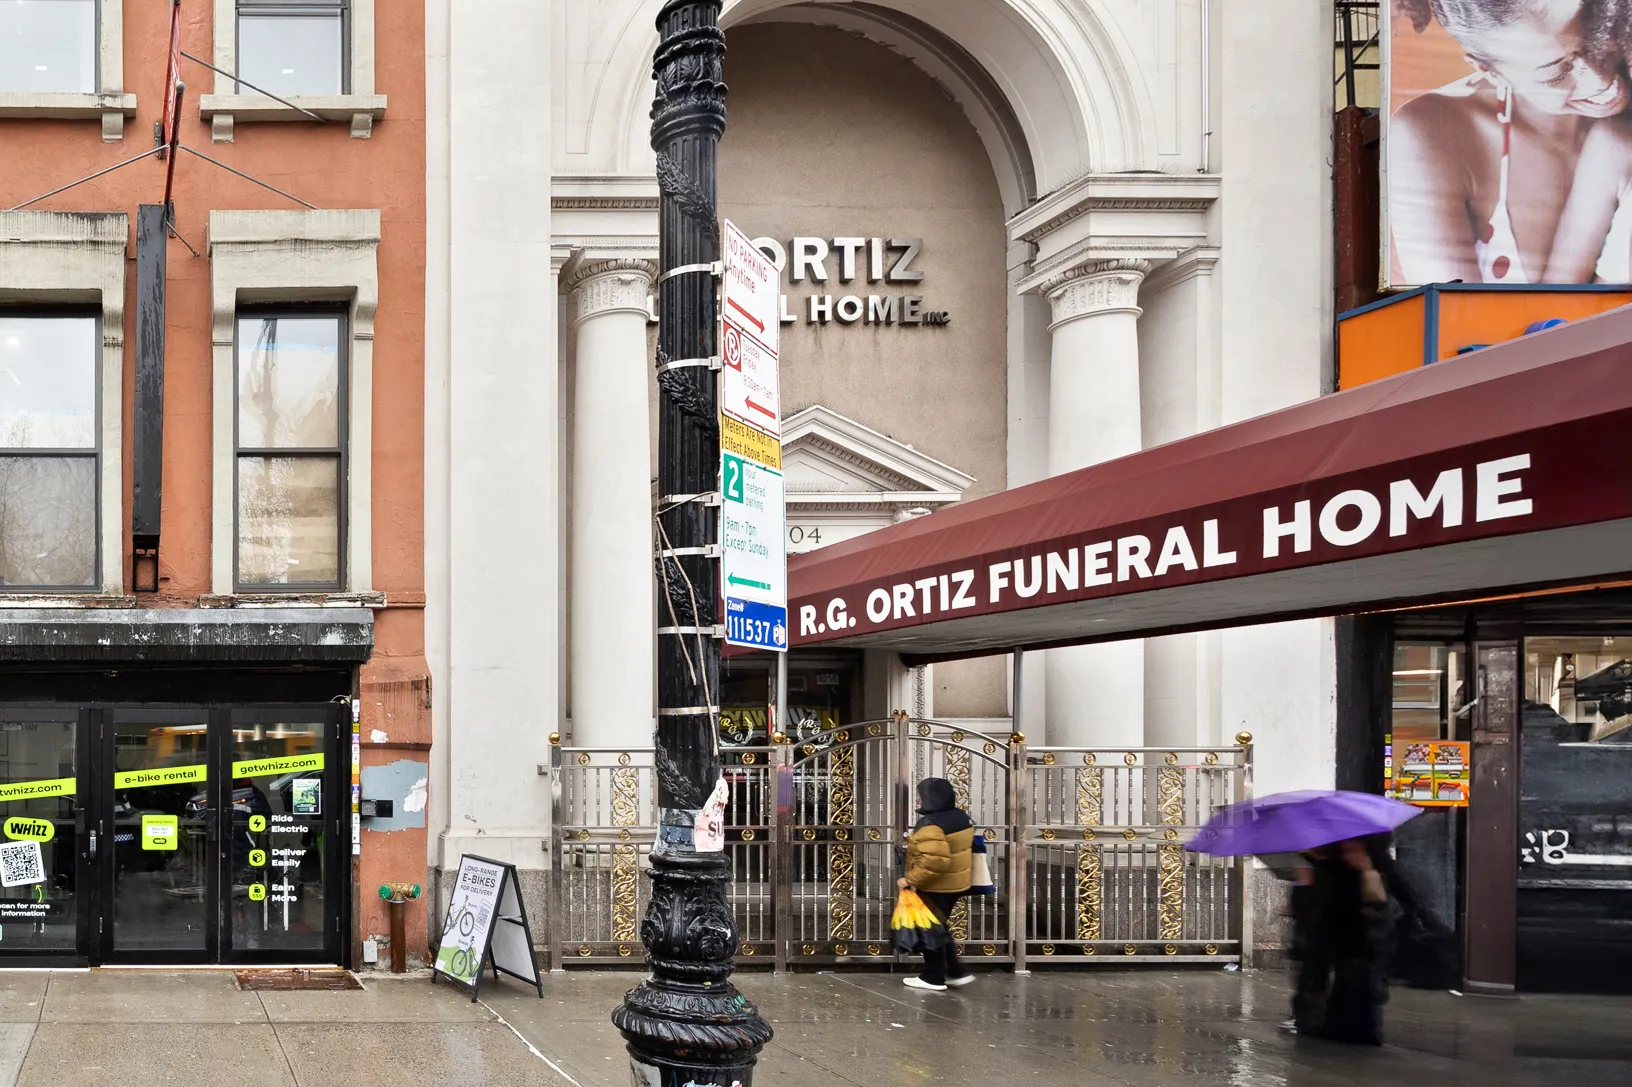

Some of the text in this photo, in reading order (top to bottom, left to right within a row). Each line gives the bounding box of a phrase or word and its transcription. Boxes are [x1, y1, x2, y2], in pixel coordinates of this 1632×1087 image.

[728, 234, 768, 283] NO PARKING
[728, 257, 756, 294] Anytime
[810, 295, 924, 323] HOME
[724, 416, 745, 438] Meters
[746, 426, 756, 442] Are
[756, 431, 767, 446] Not
[724, 435, 777, 468] Effect Above Times
[728, 459, 739, 499] 2
[725, 516, 740, 532] 9am
[745, 521, 758, 537] 7pm
[725, 533, 769, 560] Except Sunday
[800, 453, 1534, 637] R.G. ORTIZ FUNERAL HOME
[727, 614, 771, 644] 111537
[240, 759, 317, 774] getwhizz.com
[124, 770, 197, 784] e-bike rental
[271, 814, 293, 822] Ride
[271, 825, 308, 833] Electric
[271, 848, 306, 856] Deliver
[271, 859, 301, 868] Easily
[464, 864, 499, 878] LONG-RANGE
[271, 883, 295, 891] Earn
[462, 873, 496, 889] E-BIKES
[271, 894, 298, 902] More
[459, 884, 494, 897] FOR DELIVERY
[17, 902, 28, 910] for
